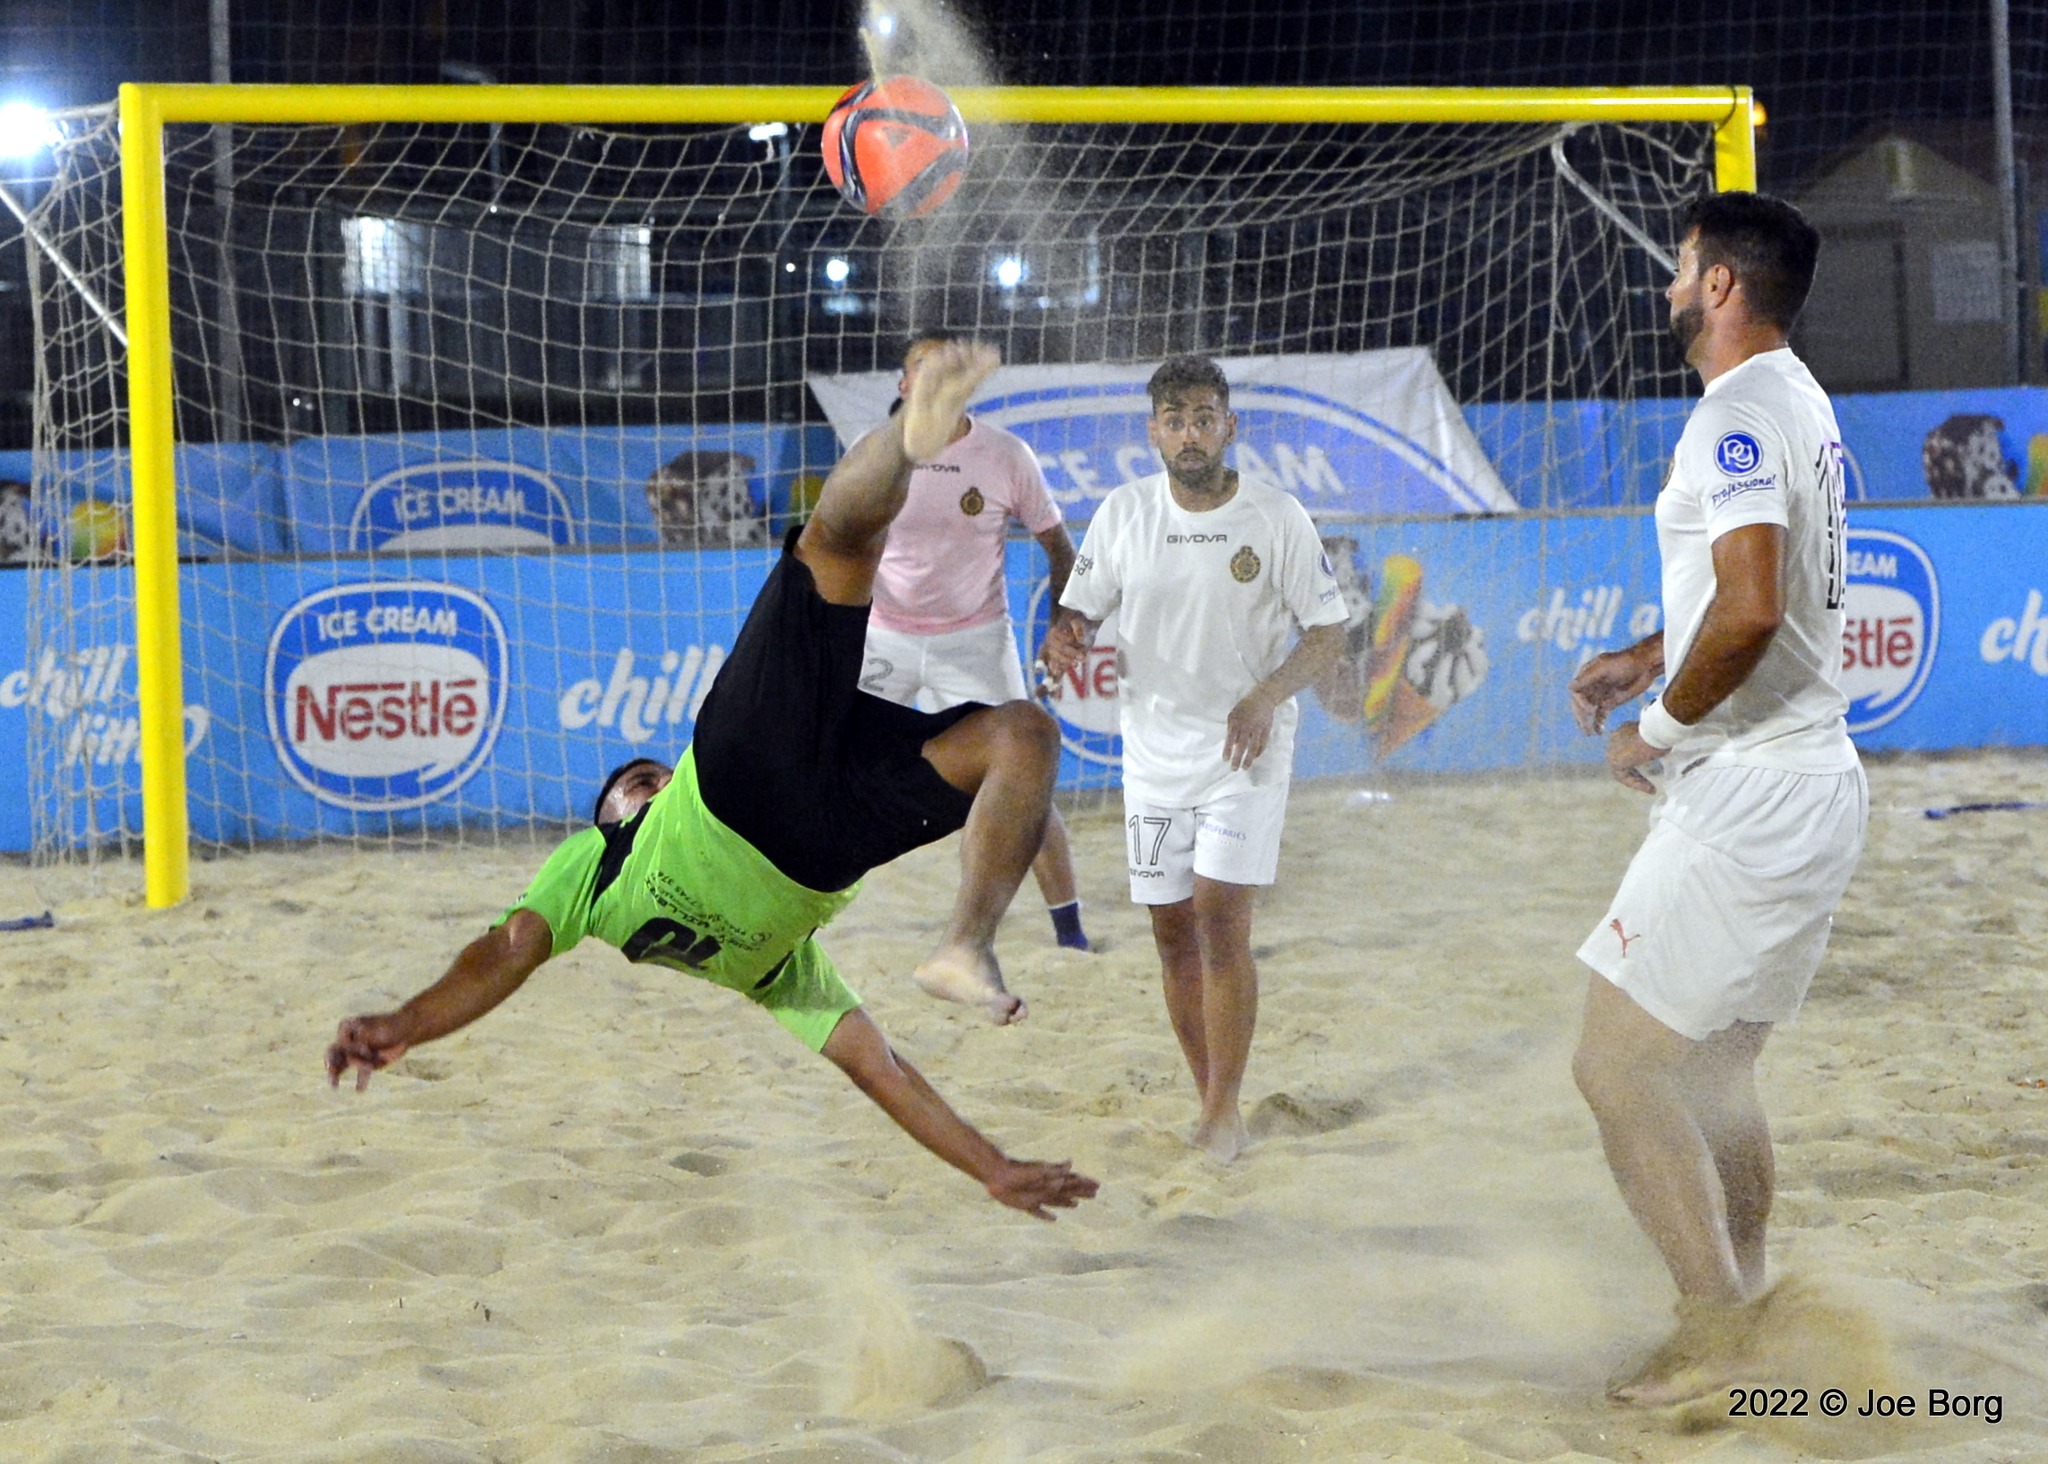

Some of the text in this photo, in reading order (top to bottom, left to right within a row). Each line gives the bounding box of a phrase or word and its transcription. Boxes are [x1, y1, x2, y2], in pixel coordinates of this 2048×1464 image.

[393, 486, 526, 522] ICE CREAM
[1166, 534, 1228, 544] GIVOVA
[318, 606, 457, 641] ICE CREAM
[1518, 585, 1623, 650] chill
[559, 644, 725, 739] chill
[860, 658, 893, 692] 2
[296, 679, 477, 742] Nestlé
[1129, 815, 1171, 866] 17
